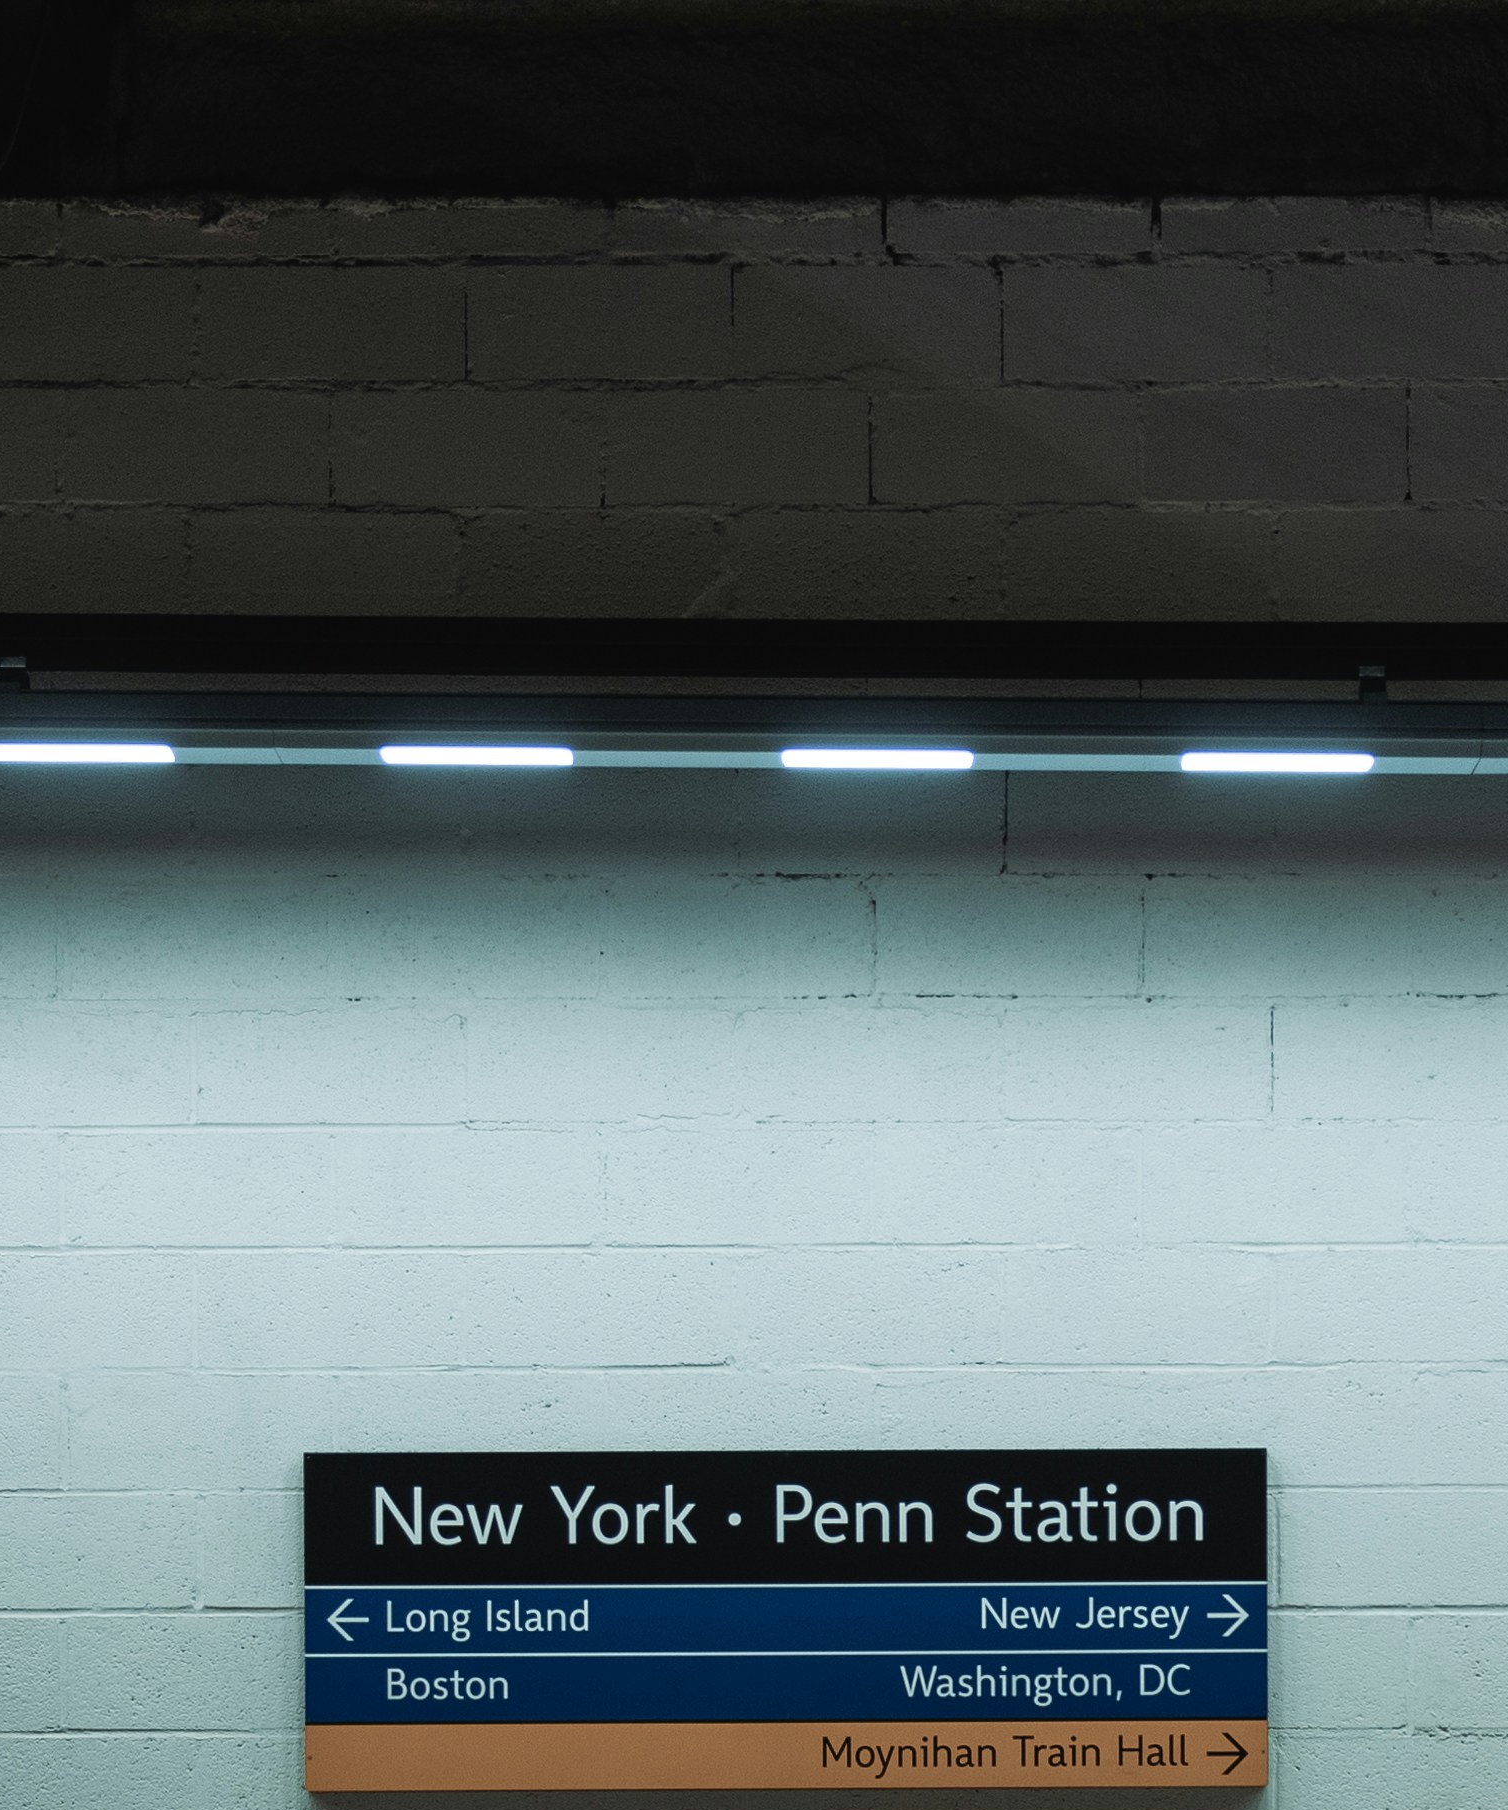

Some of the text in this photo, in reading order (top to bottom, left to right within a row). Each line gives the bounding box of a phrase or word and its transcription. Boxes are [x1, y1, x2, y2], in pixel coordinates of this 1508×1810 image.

[374, 1486, 523, 1546] New
[550, 1484, 697, 1545] York
[776, 1484, 934, 1544] Penn
[966, 1482, 1204, 1543] Station
[386, 1599, 590, 1642] Long Island
[981, 1596, 1190, 1640] New Jersey
[387, 1668, 509, 1700] Boston
[899, 1663, 1191, 1707] Washington, DC
[822, 1733, 1189, 1775] Moynihan Train Hall
